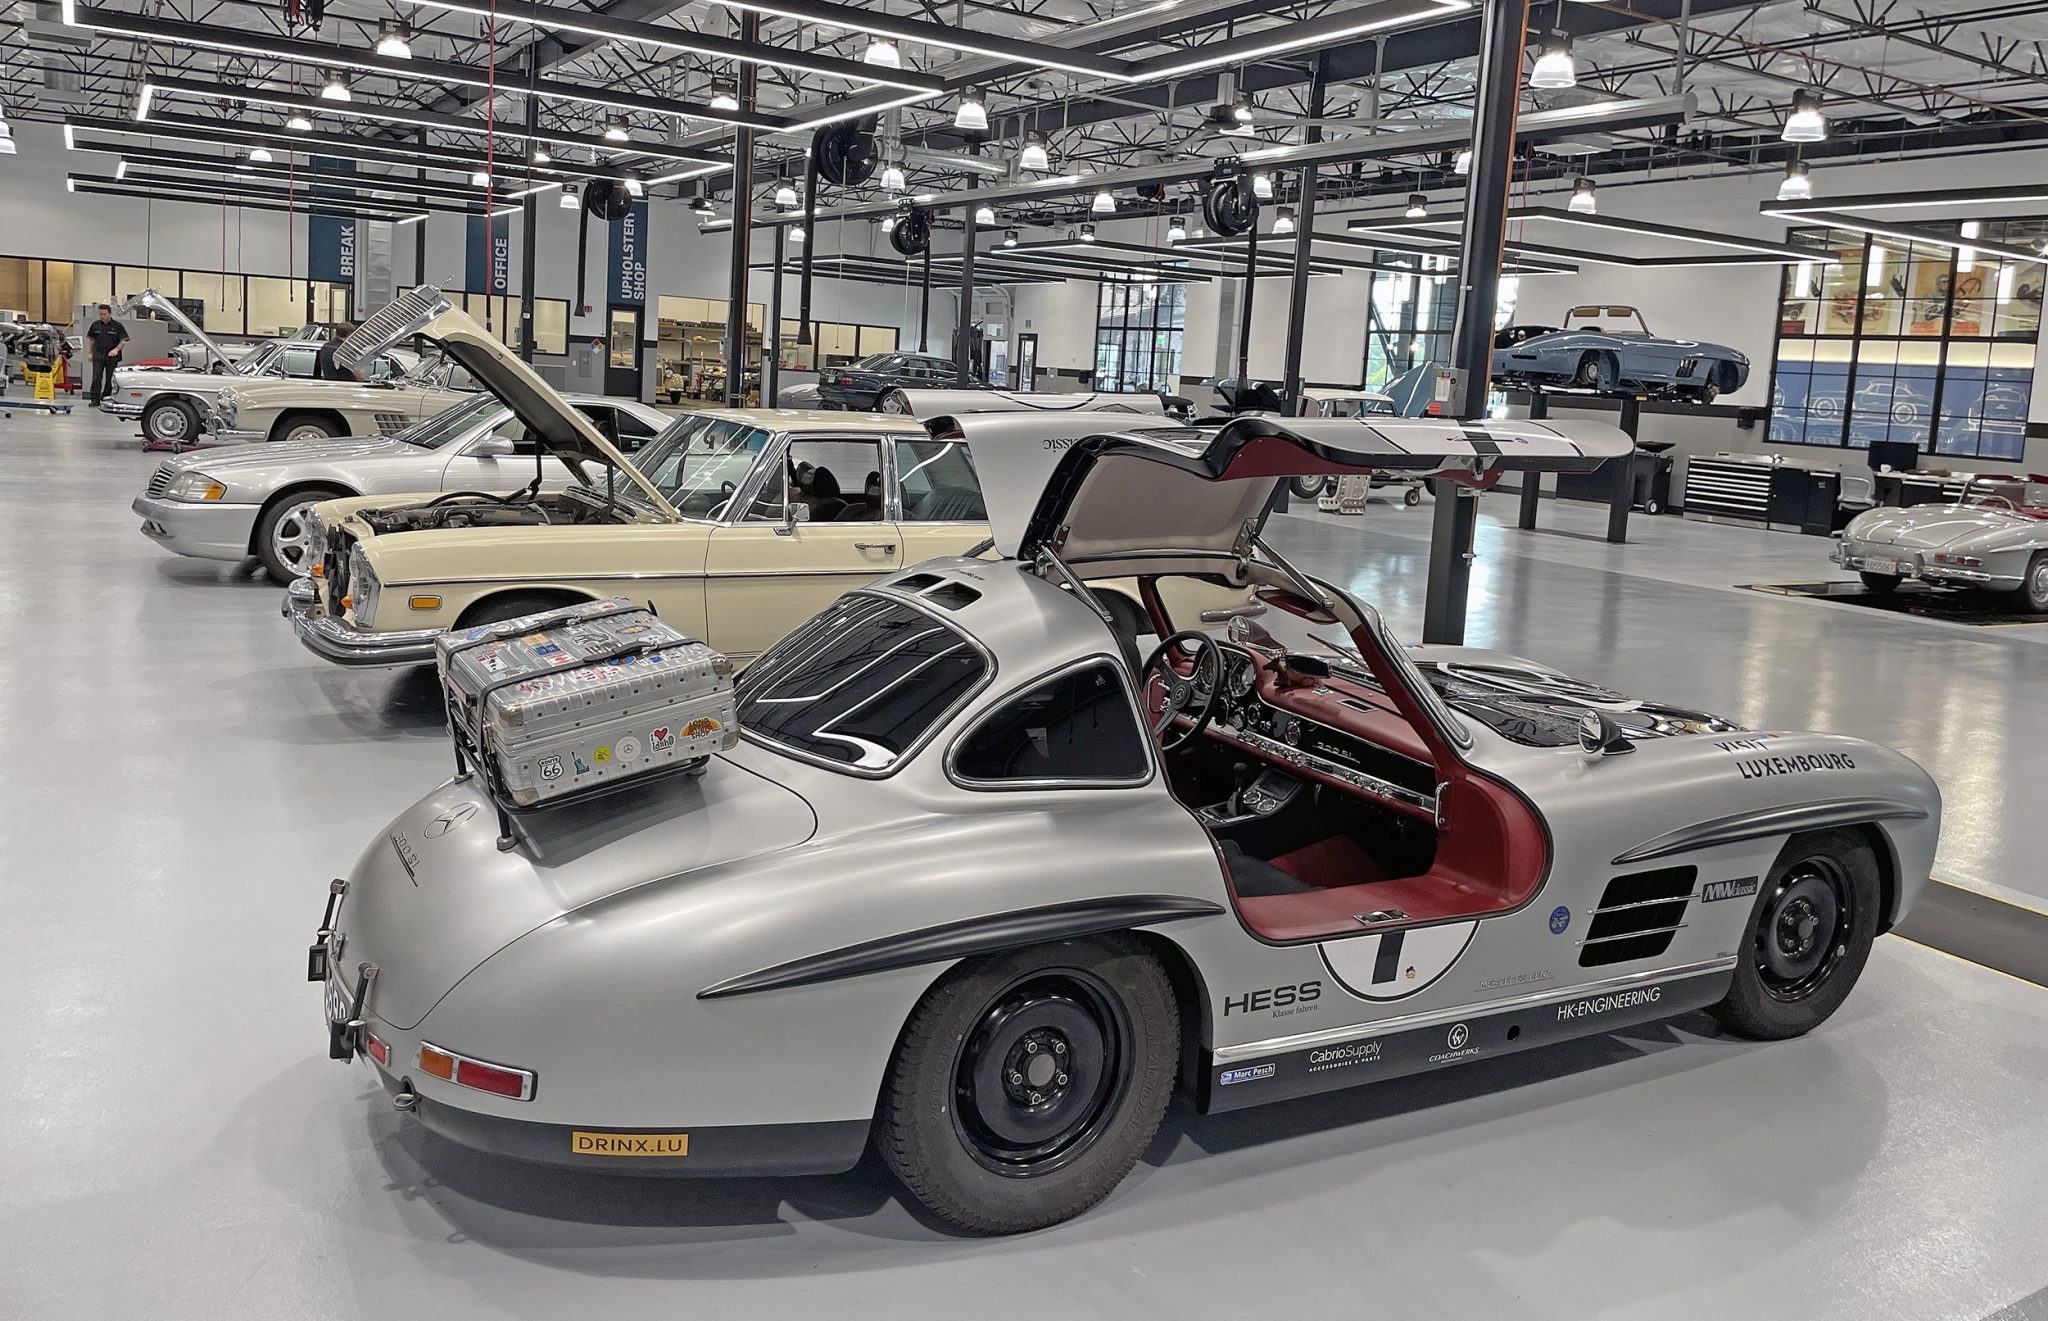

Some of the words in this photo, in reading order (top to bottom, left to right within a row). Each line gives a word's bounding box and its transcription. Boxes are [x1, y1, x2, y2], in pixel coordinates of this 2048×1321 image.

[340, 225, 354, 276] BREAK
[621, 211, 635, 299] UPHOLSTERY
[494, 238, 507, 289] OFFICE
[634, 262, 645, 300] SHOP
[1714, 739, 1768, 754] VISIT
[541, 757, 558, 765] ROUTE
[544, 763, 560, 777] 66
[1736, 753, 1856, 780] LUXEMBOURG
[1224, 980, 1322, 1017] HESS
[1557, 986, 1662, 1021] HK-ENGINEERING
[1272, 1007, 1294, 1019] Klasse
[1308, 1060, 1352, 1073] ACCESSORIES
[1361, 1055, 1381, 1063] PARTS
[1309, 1040, 1383, 1064] CabrioSupply
[1234, 1070, 1252, 1080] Marc
[1253, 1065, 1273, 1076] Pesch
[578, 1136, 683, 1152] DRINX.LU
